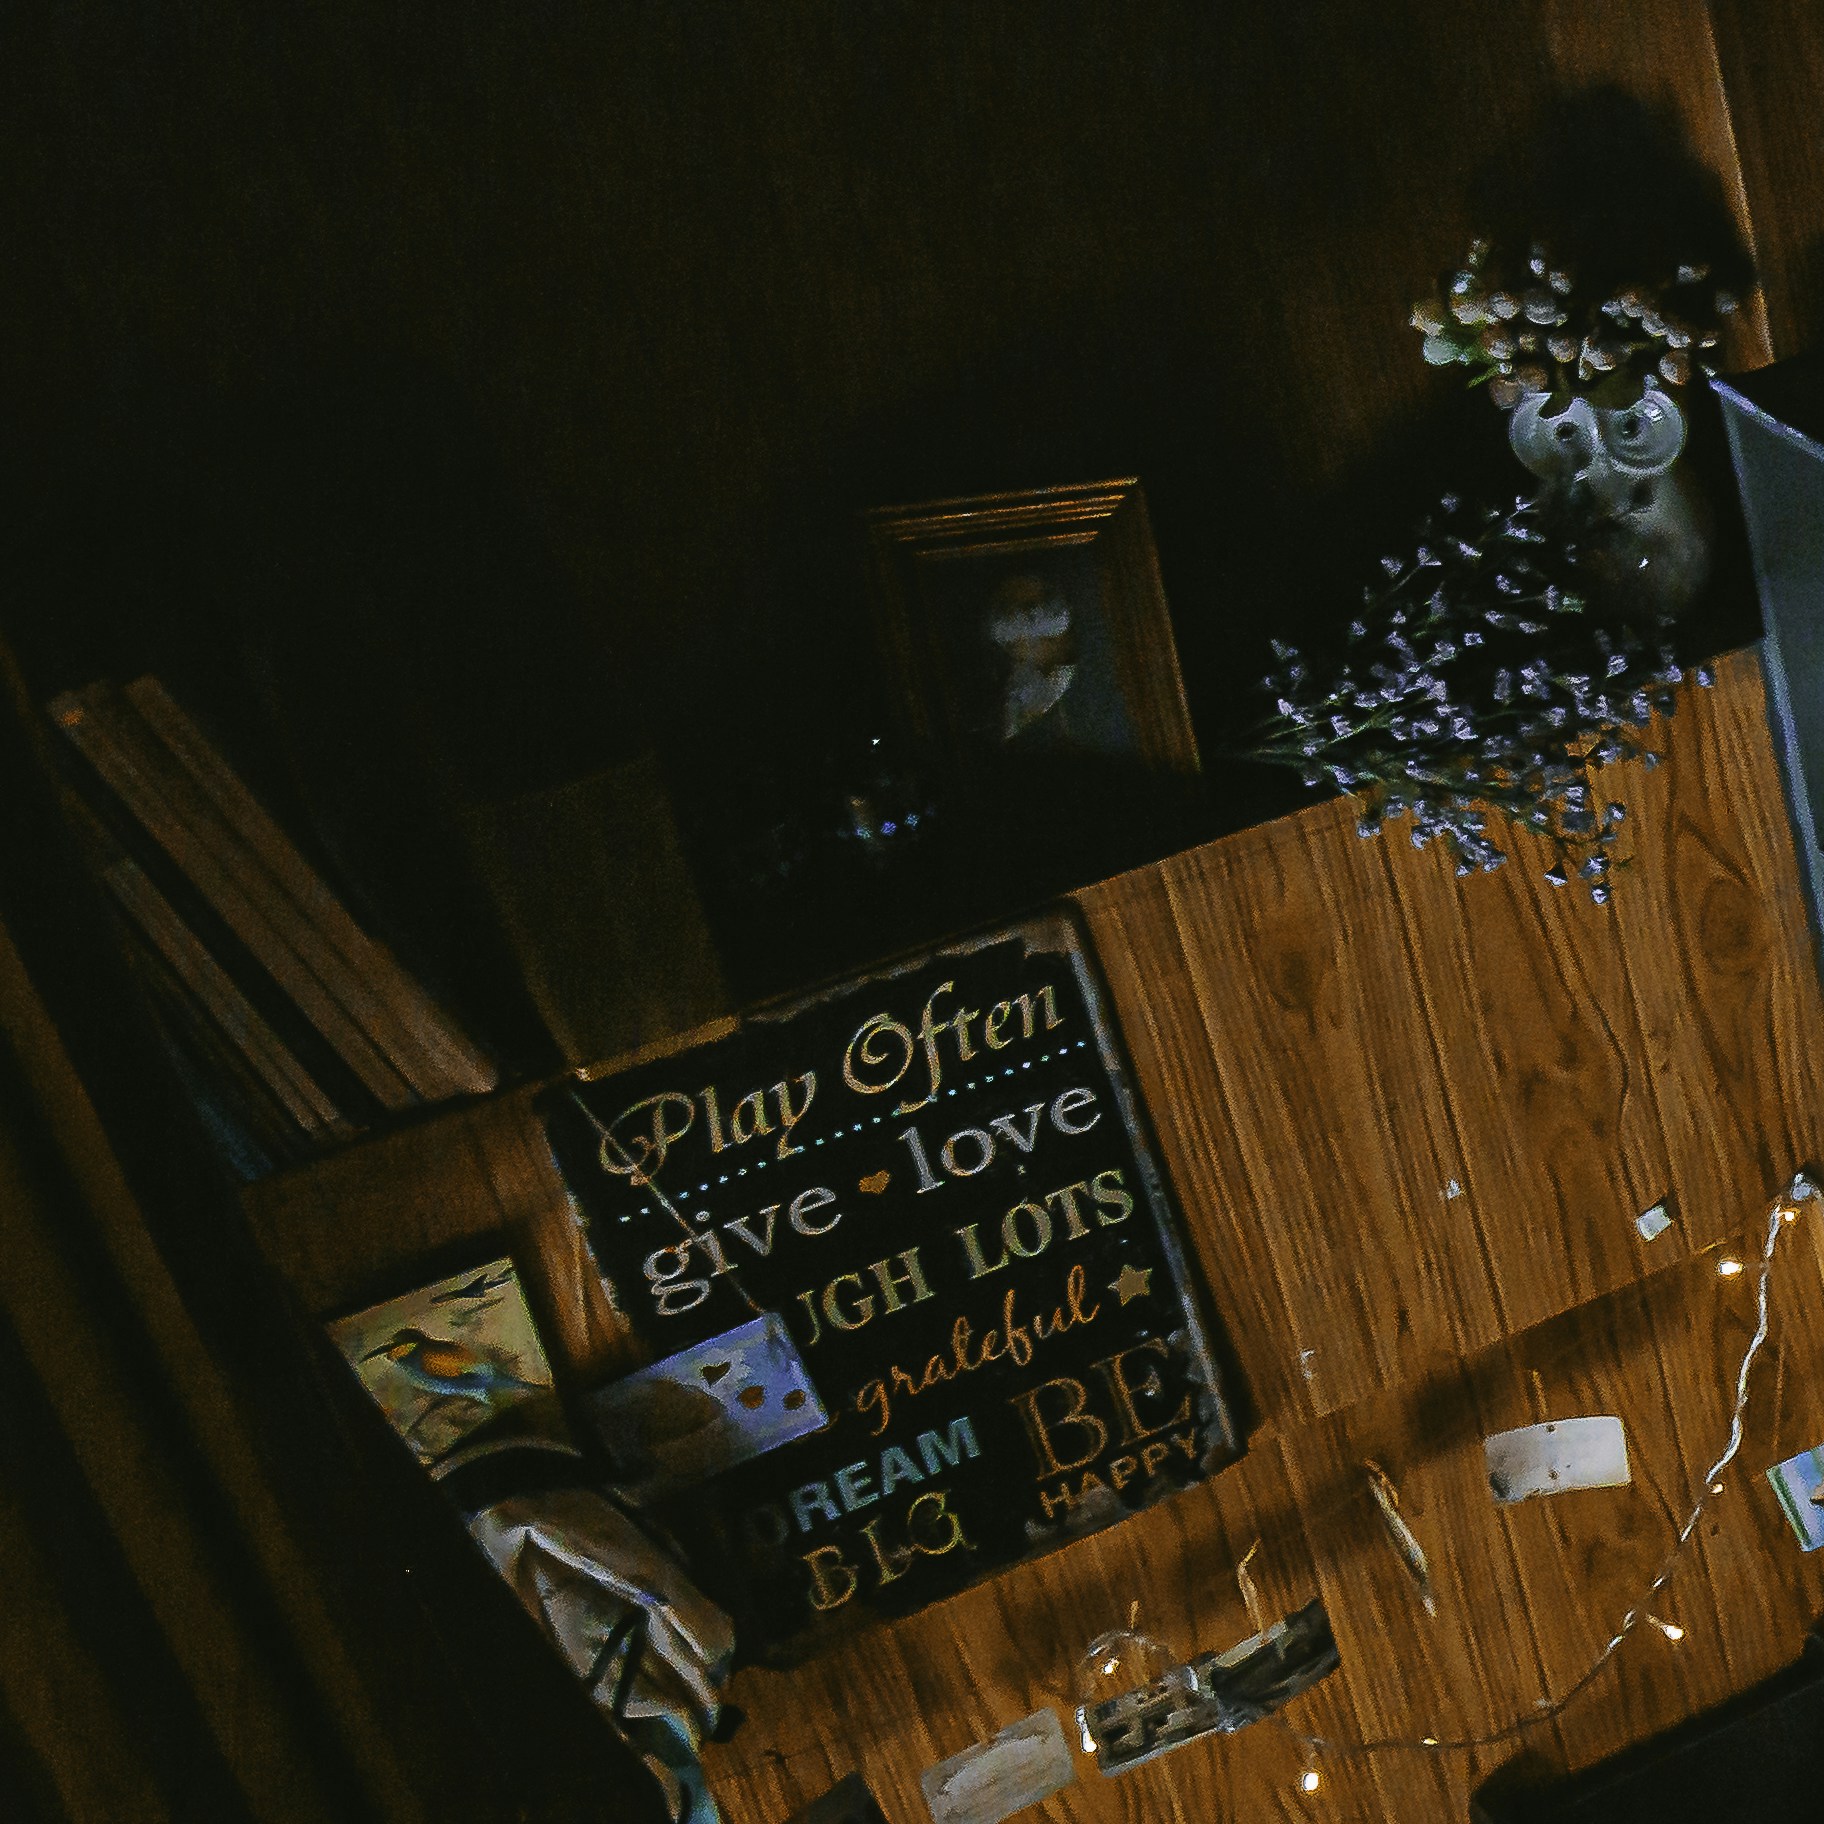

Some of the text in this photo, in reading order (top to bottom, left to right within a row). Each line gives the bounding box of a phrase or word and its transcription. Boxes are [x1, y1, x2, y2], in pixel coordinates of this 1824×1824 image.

[600, 980, 1067, 1187] Play Often
[642, 1085, 1103, 1316] give love
[953, 1168, 1135, 1280] LOTS
[855, 1263, 1101, 1438] grateful
[1006, 1336, 1193, 1483] BE
[1039, 1426, 1198, 1519] HAPPY
